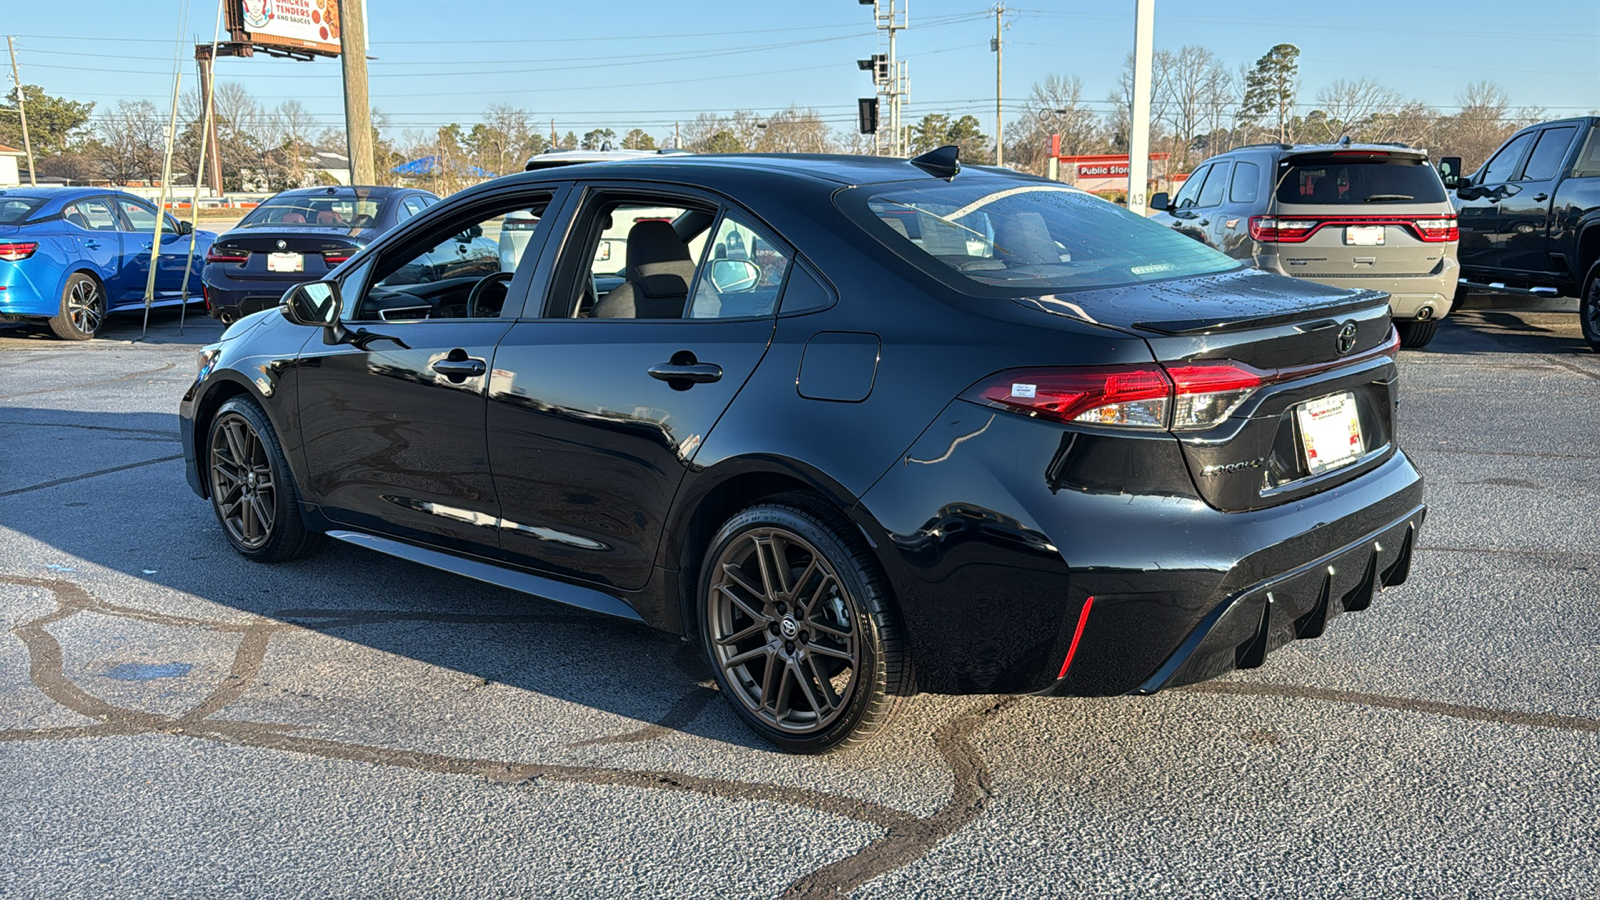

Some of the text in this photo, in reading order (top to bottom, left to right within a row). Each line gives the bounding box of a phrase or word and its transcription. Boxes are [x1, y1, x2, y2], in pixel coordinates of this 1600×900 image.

[276, 4, 310, 18] TENDERS
[290, 16, 311, 25] SAUCES
[1081, 166, 1108, 175] Public
[1131, 193, 1144, 206] A3
